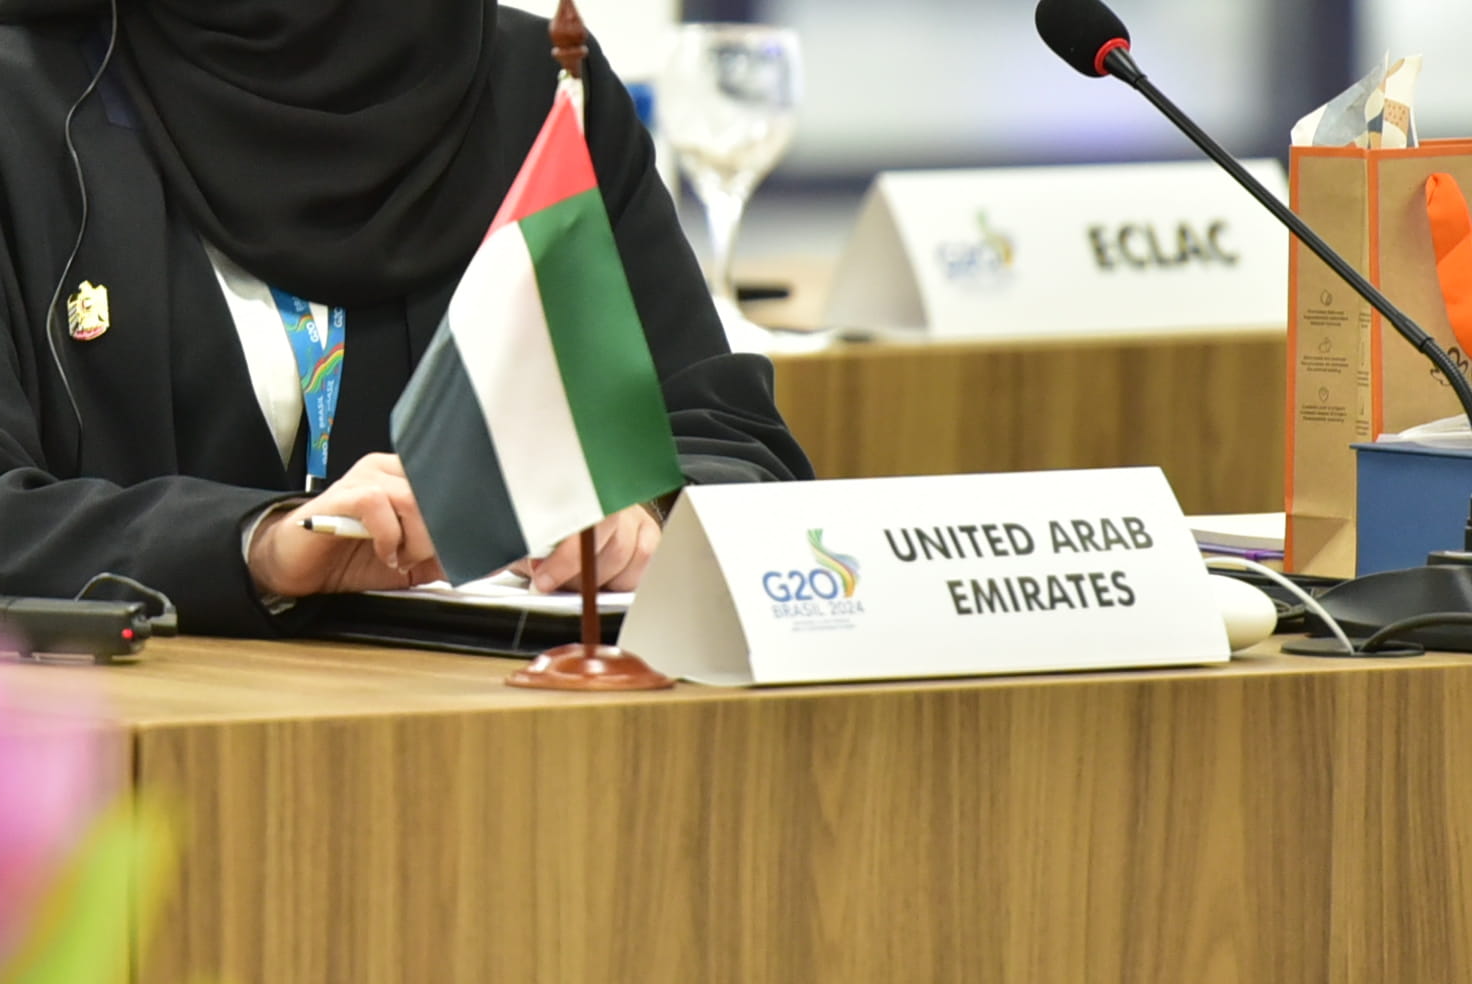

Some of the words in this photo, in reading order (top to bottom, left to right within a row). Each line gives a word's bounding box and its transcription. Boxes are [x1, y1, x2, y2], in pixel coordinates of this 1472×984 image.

[1087, 219, 1239, 270] ECLAC
[883, 522, 1036, 563] UNITED
[1048, 516, 1154, 554] ARAB
[762, 568, 839, 603] G20
[827, 599, 865, 616] 2024
[945, 570, 1137, 616] EMIRATES
